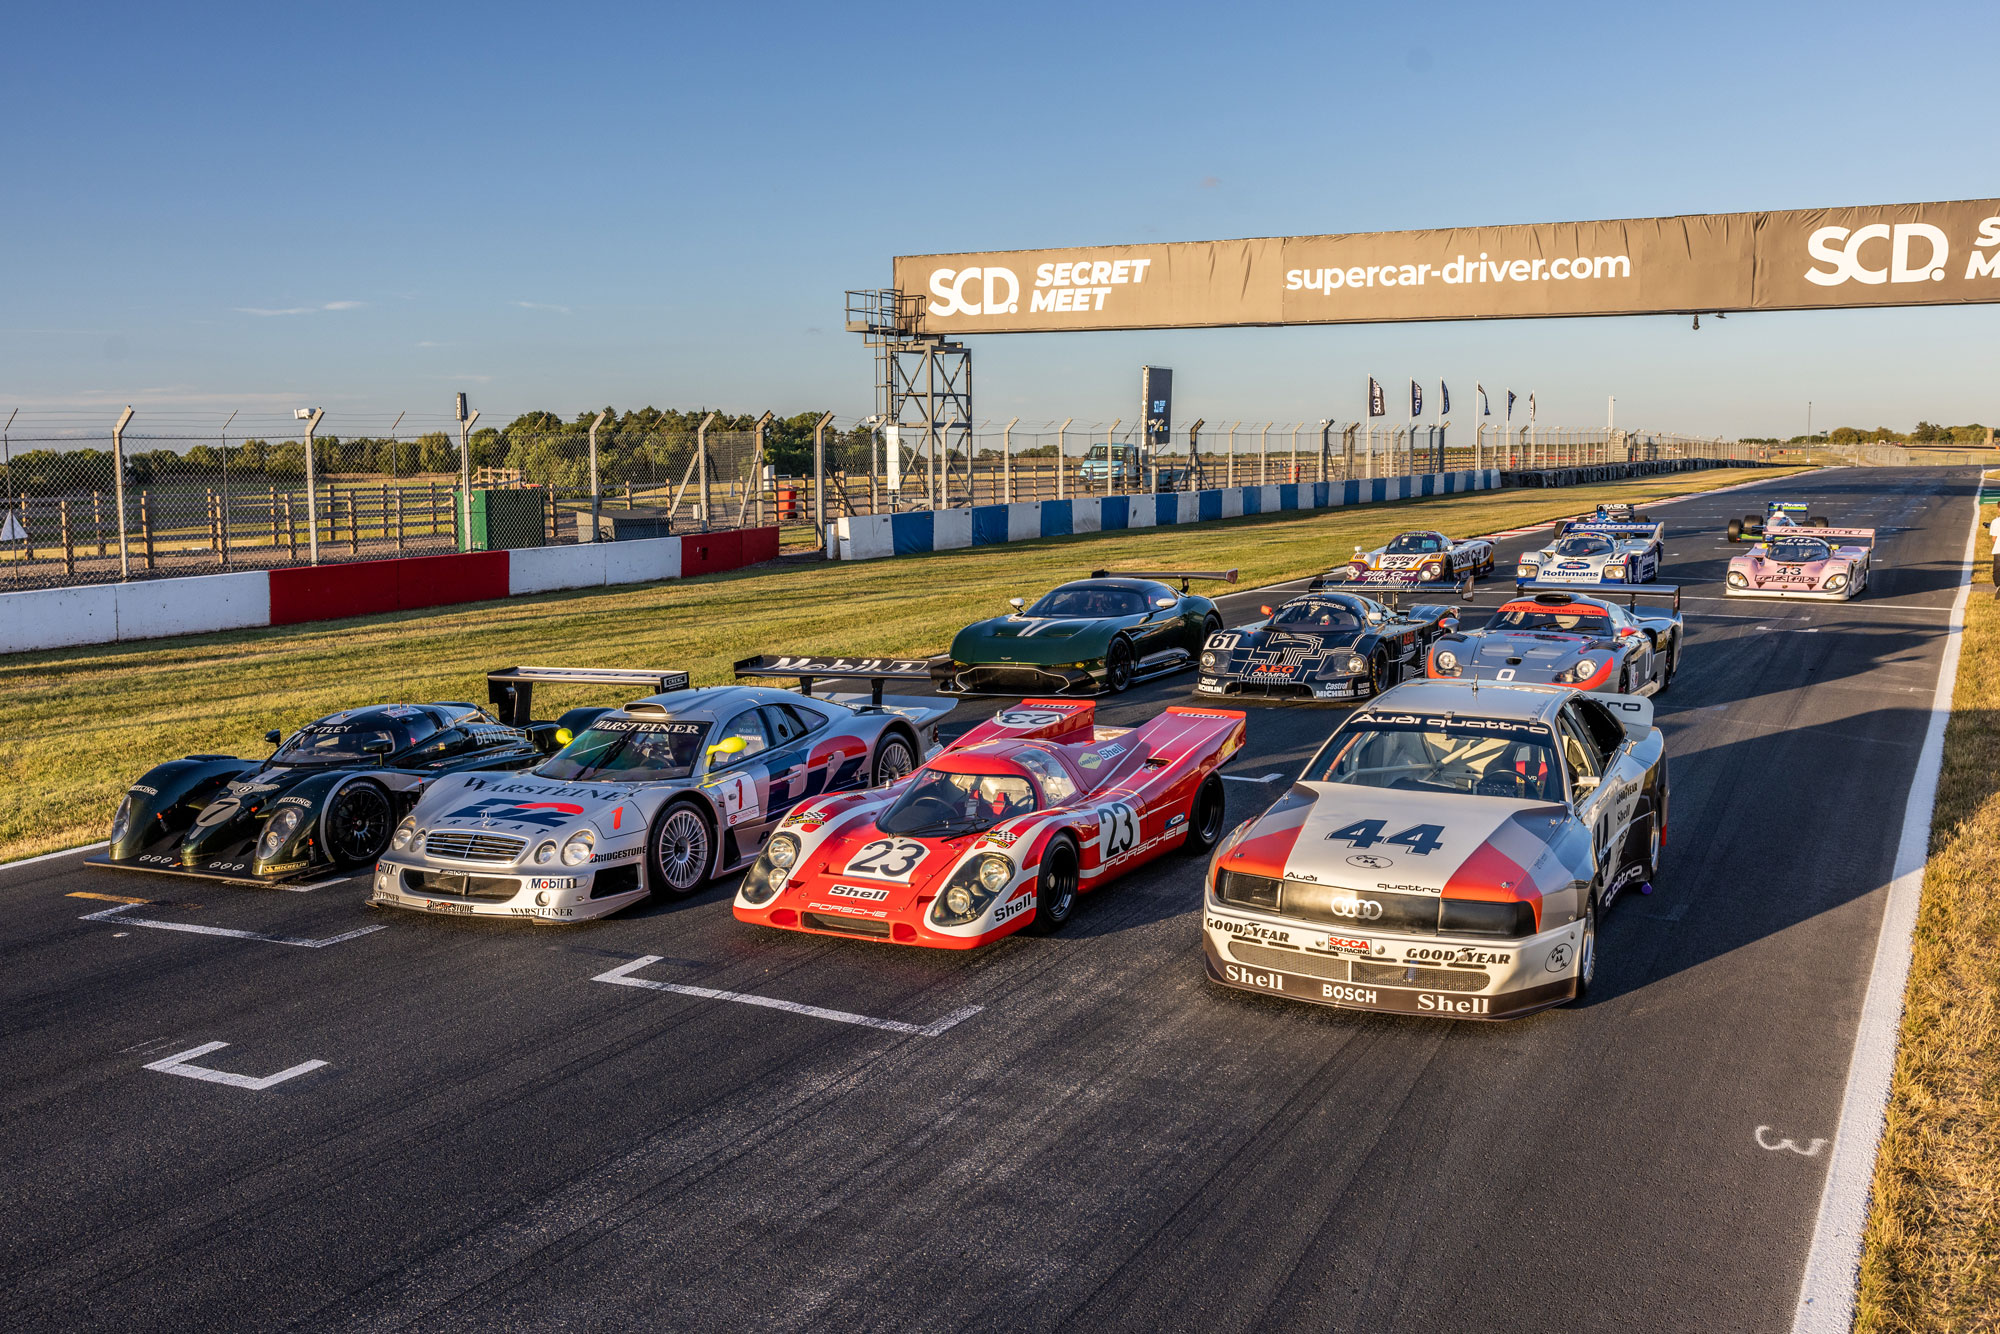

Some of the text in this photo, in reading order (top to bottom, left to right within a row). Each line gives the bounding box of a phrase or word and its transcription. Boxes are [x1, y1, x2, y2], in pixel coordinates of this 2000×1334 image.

[1034, 258, 1151, 287] SECRET
[1285, 252, 1631, 296] supercar-driver.com
[1029, 287, 1112, 313] MEET
[1383, 561, 1410, 570] 22
[1777, 567, 1801, 575] 43
[1282, 601, 1346, 611] SAUBER MERCEDES
[1208, 634, 1236, 649] 61
[763, 657, 881, 673] Mobil
[1256, 665, 1295, 673] AEG
[1201, 676, 1218, 685] Castrol
[1496, 668, 1516, 681] 0
[1316, 689, 1354, 698] MICHELIN
[1325, 682, 1348, 690] Castrol
[593, 720, 700, 734] WARSTEINER
[1351, 713, 1549, 735] Audi quattro
[473, 727, 518, 746] BENTLEY
[1100, 744, 1124, 759] Shell
[464, 777, 644, 801] WARSTEINER
[1616, 782, 1638, 805] GOODYEAR
[200, 801, 240, 823] 7
[611, 807, 624, 830] 1
[1617, 804, 1631, 825] Shell
[1097, 803, 1134, 858] 23
[1324, 819, 1446, 856] 44
[589, 845, 647, 864] BRIDGESTONE
[848, 839, 926, 877] 23
[1104, 828, 1177, 872] PORSCHE
[274, 862, 308, 871] MICHELIN
[531, 878, 564, 890] Mobil
[1285, 871, 1318, 882] Audi
[831, 884, 889, 901] Shell
[1377, 883, 1441, 894] quattro
[1605, 864, 1643, 908] quattro
[511, 907, 573, 917] WARSTEINER
[808, 902, 888, 918] PORSCHE
[994, 894, 1031, 922] Shell
[1207, 917, 1290, 942] GOODYEAR
[1329, 936, 1370, 950] SCCA
[1329, 945, 1371, 956] PRO RACING
[1406, 948, 1511, 965] GOODYEAR
[1226, 964, 1284, 991] Shell
[1322, 983, 1377, 1004] BOSCH
[1417, 993, 1490, 1015] Shell
